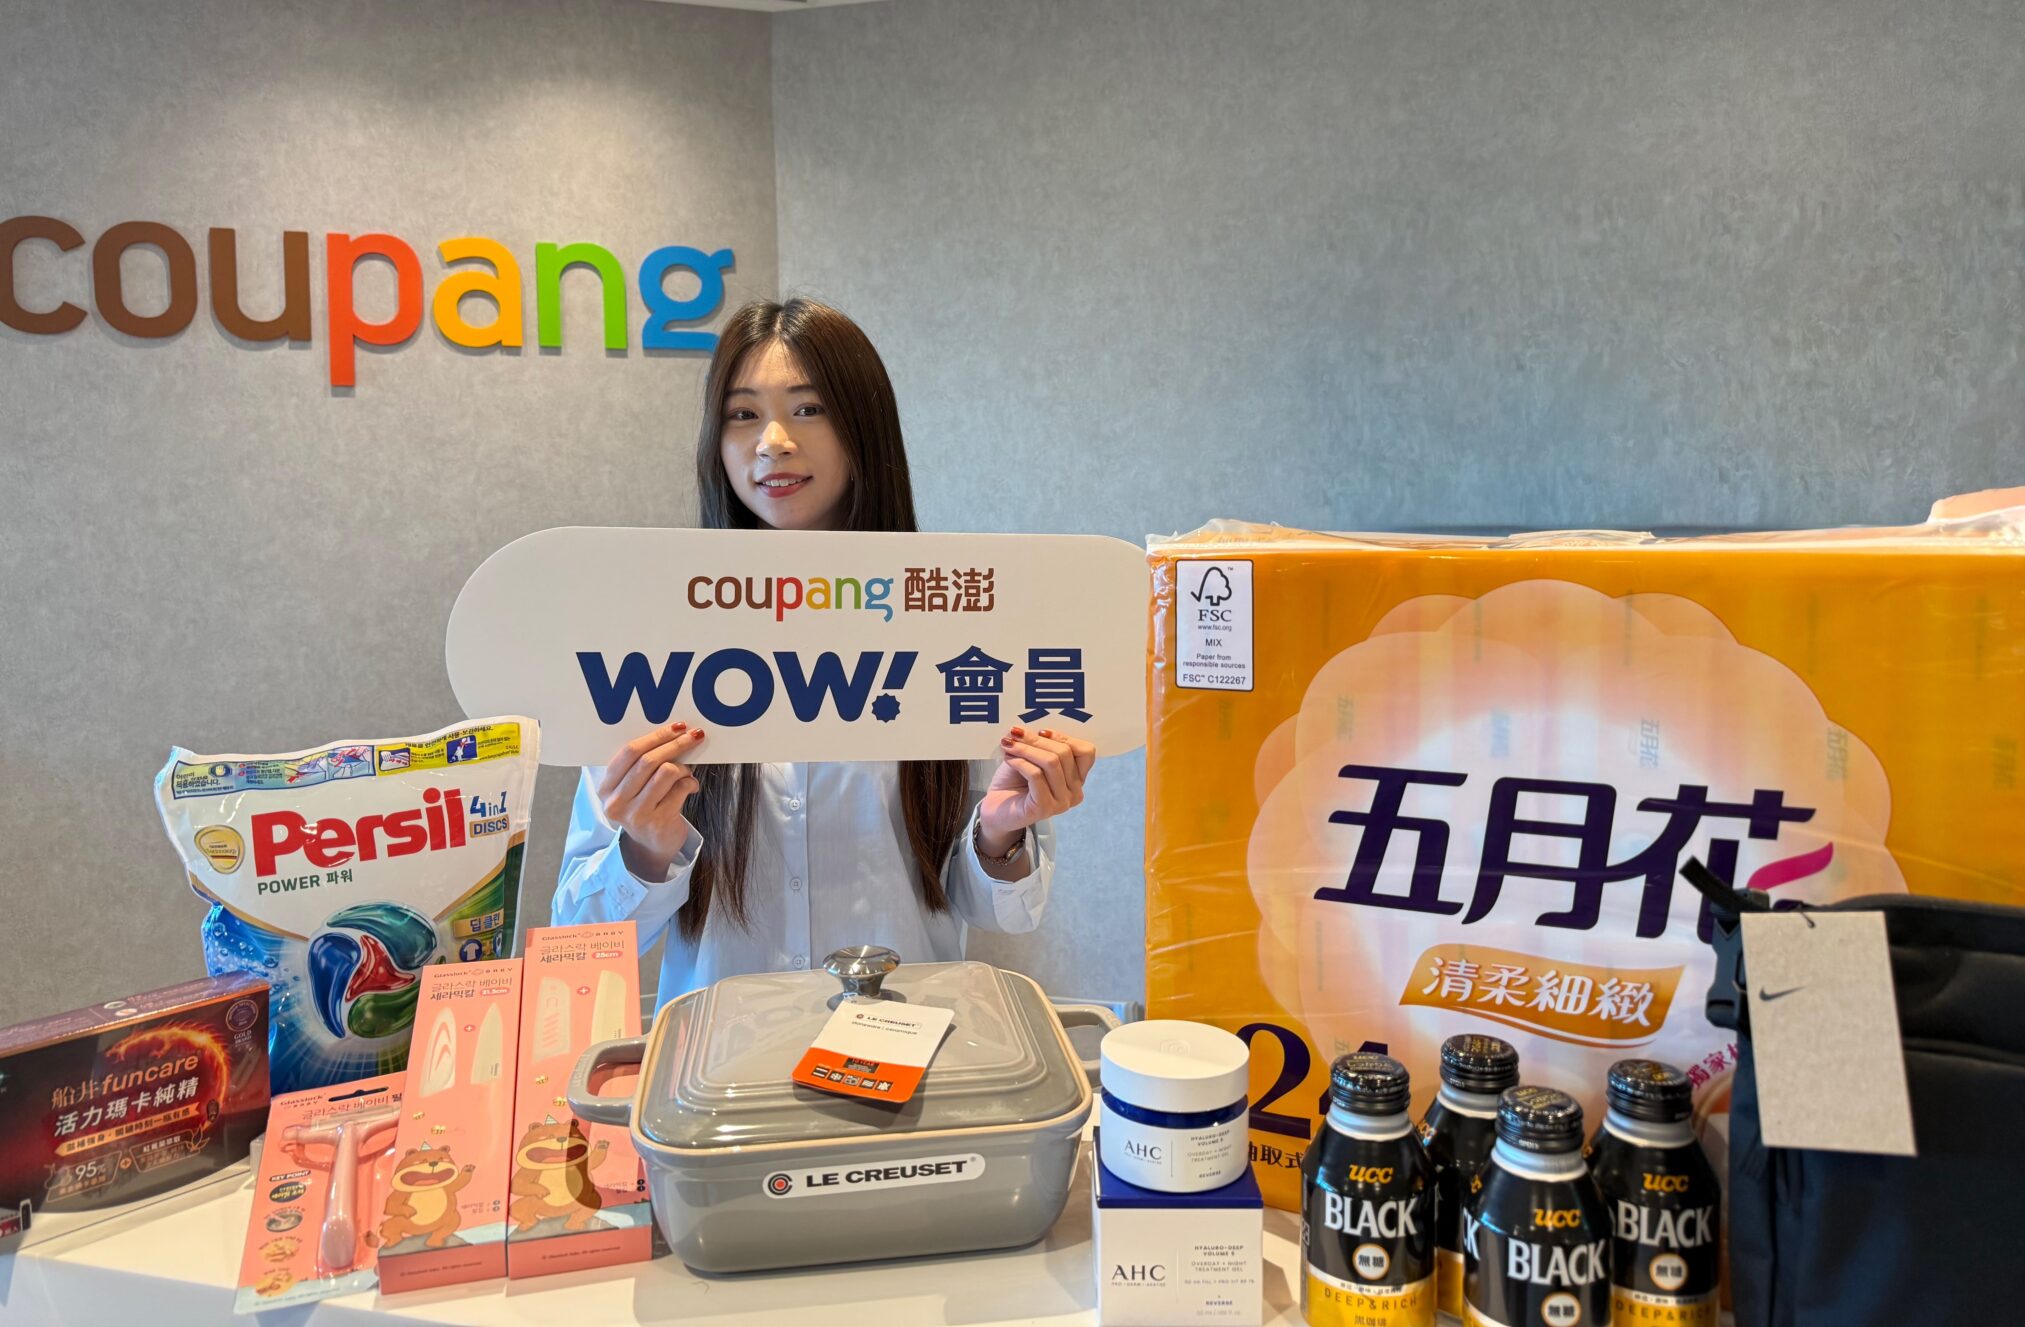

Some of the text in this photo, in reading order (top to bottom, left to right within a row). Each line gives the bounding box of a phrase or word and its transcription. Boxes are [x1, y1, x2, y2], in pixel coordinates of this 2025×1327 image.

[0, 215, 736, 387] coupang
[688, 567, 995, 622] coupang 酷澎
[1198, 609, 1232, 622] FSC
[1198, 624, 1232, 632] www.fsc.org
[1205, 638, 1222, 647] MIX
[1183, 660, 1218, 669] responsible
[1197, 653, 1231, 661] Paper from
[576, 645, 1094, 726] WOW! 會員
[1208, 675, 1246, 685] C122267
[251, 787, 466, 877] Persil
[473, 818, 508, 836] DISCS
[1314, 765, 1833, 944] 五月花
[257, 868, 353, 896] POWER 파워
[590, 940, 625, 951] 베이비
[540, 951, 586, 964] 세라믹칼
[479, 976, 513, 987] 베이비
[1422, 956, 1656, 1026] 清柔細緻
[430, 989, 476, 1001] 세라믹칼
[101, 1055, 199, 1096] funcare
[54, 1076, 200, 1137] 活力瑪卡純精
[353, 1096, 388, 1109] 베이비
[1124, 1140, 1163, 1160] AHC
[271, 1169, 311, 1182] KEY POINT
[806, 1160, 968, 1188] LE CREUSET
[1324, 1190, 1418, 1239] BLACK
[1617, 1200, 1713, 1248] BLACK
[1507, 1237, 1606, 1286] BLACK
[1111, 1264, 1166, 1281] AHC
